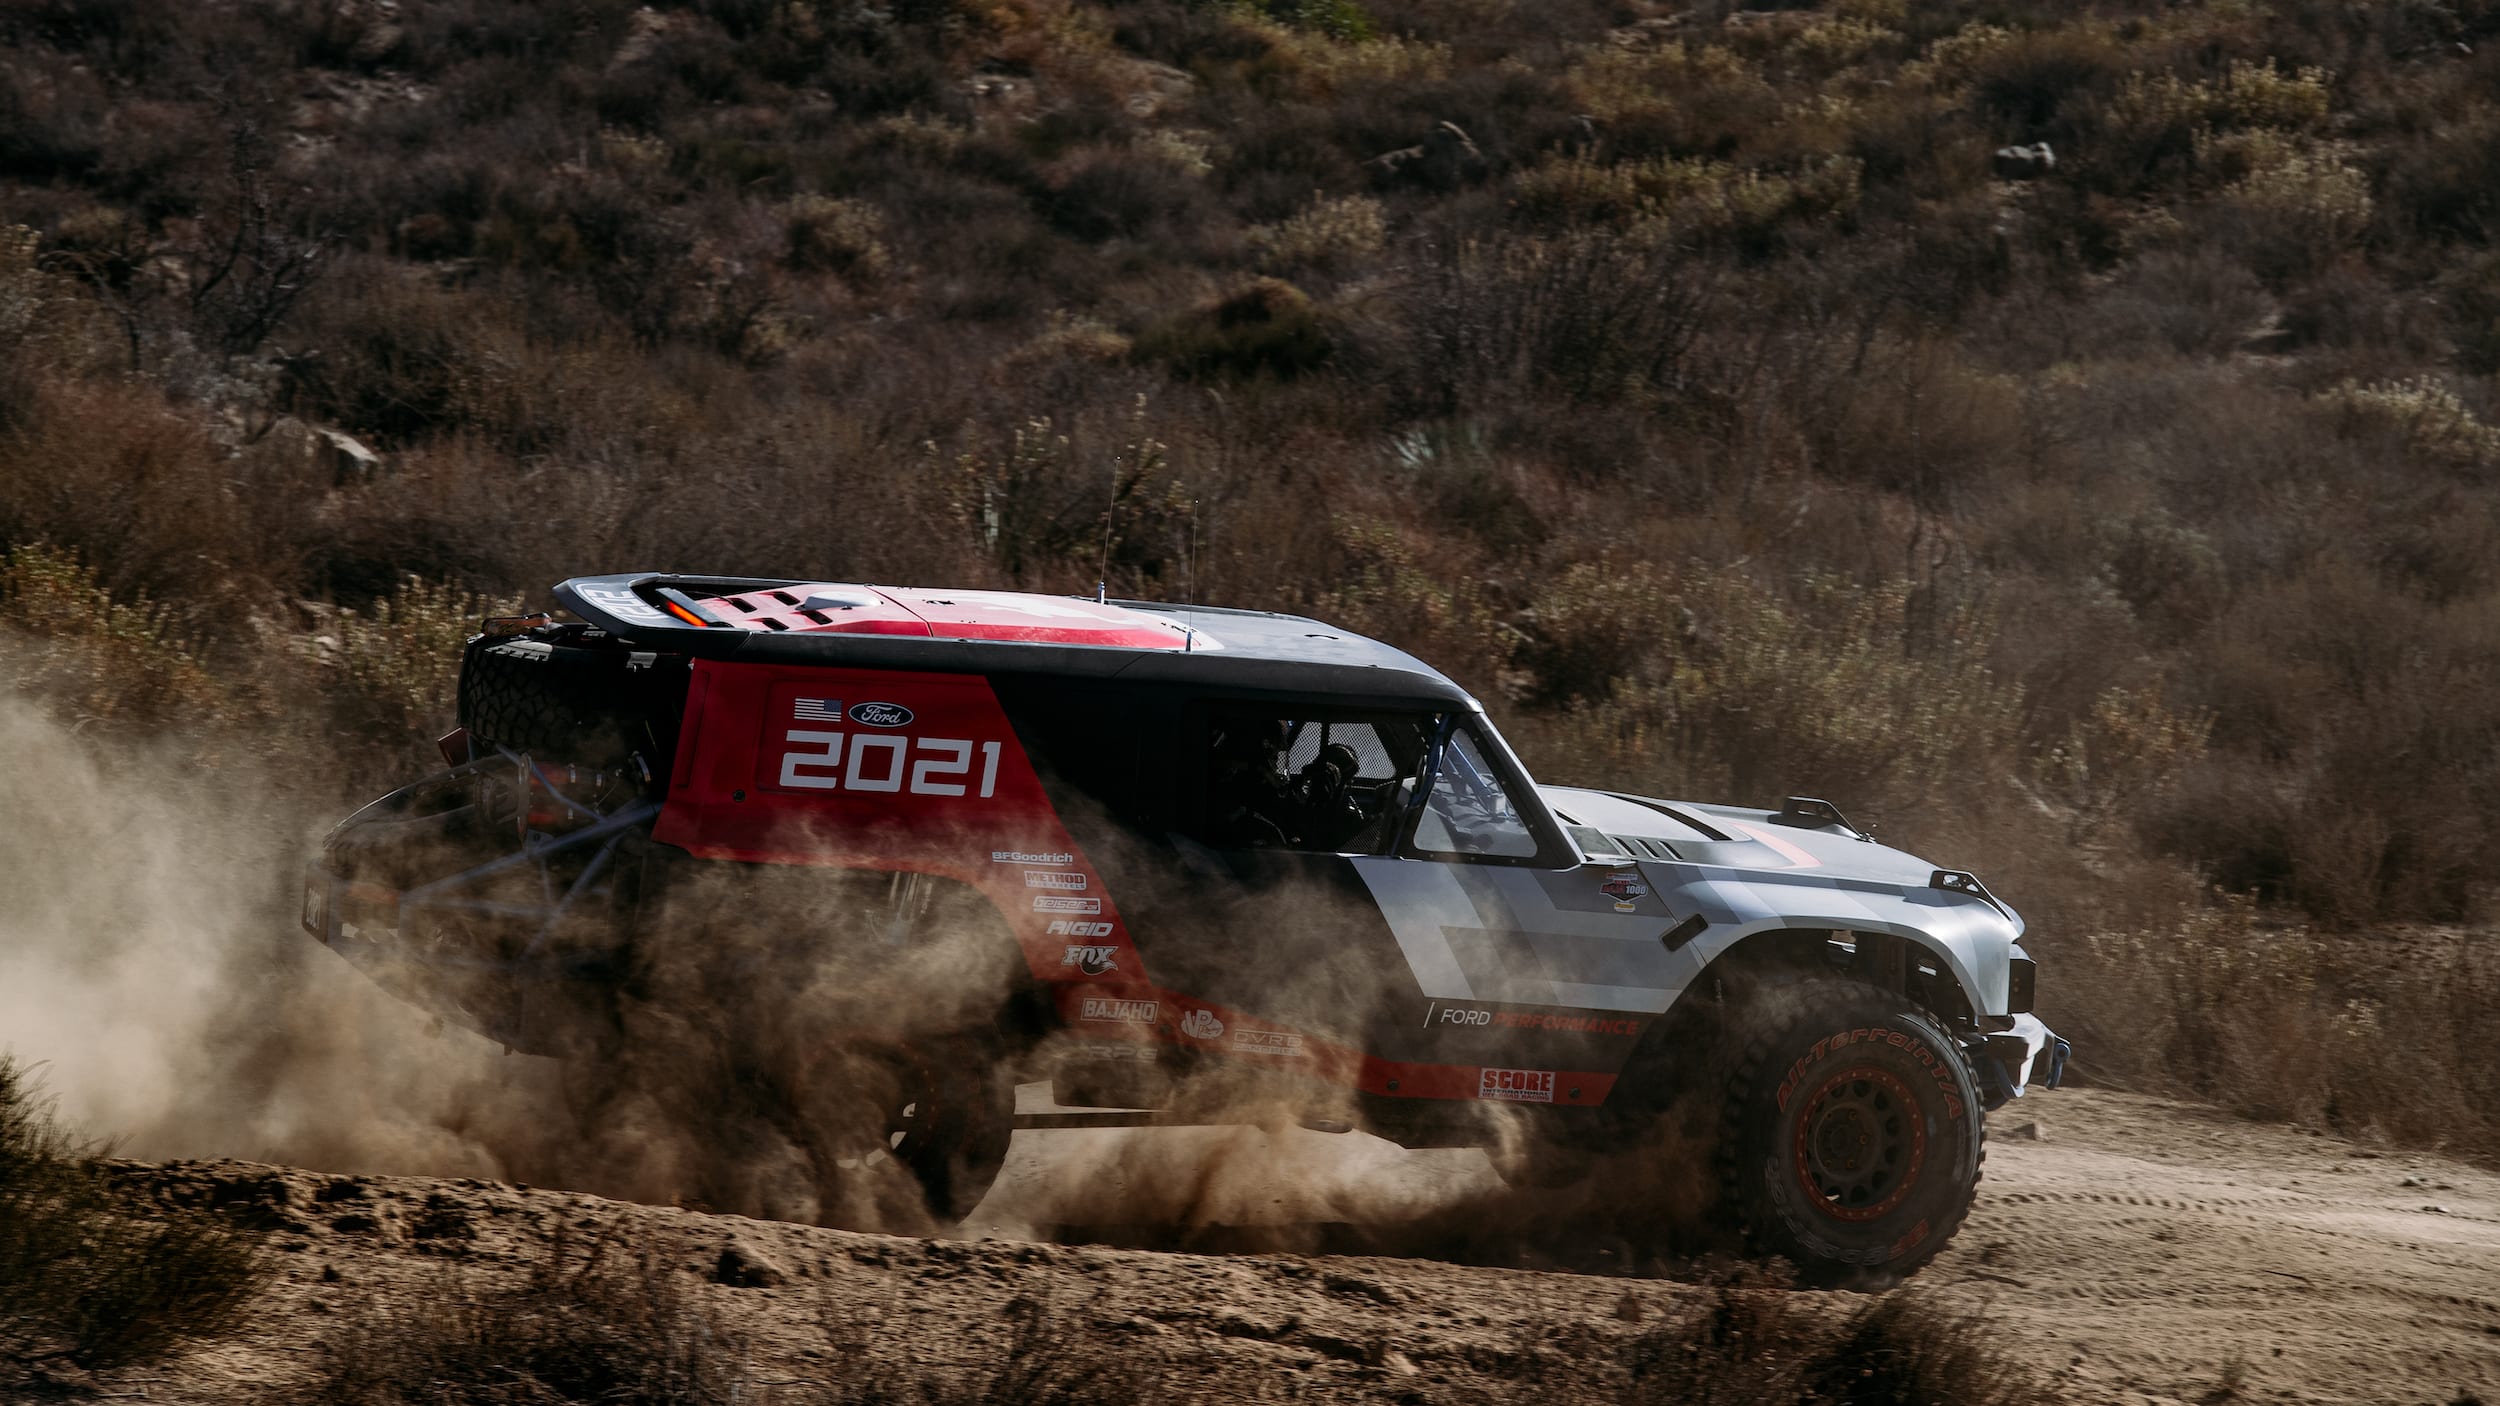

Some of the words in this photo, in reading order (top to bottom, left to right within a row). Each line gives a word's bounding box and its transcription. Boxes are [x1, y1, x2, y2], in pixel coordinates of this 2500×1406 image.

[861, 704, 901, 724] Ford
[779, 729, 1001, 798] 2021
[992, 851, 1073, 864] BFGoodrich
[1026, 872, 1084, 885] METHOD
[1047, 920, 1113, 937] RIGID
[1061, 945, 1119, 967] FOX
[1084, 1000, 1156, 1022] BAJAHQ
[1440, 1009, 1491, 1026] FORD
[1492, 1012, 1640, 1035] PERFORMANCE
[1483, 1070, 1551, 1091] SCORE
